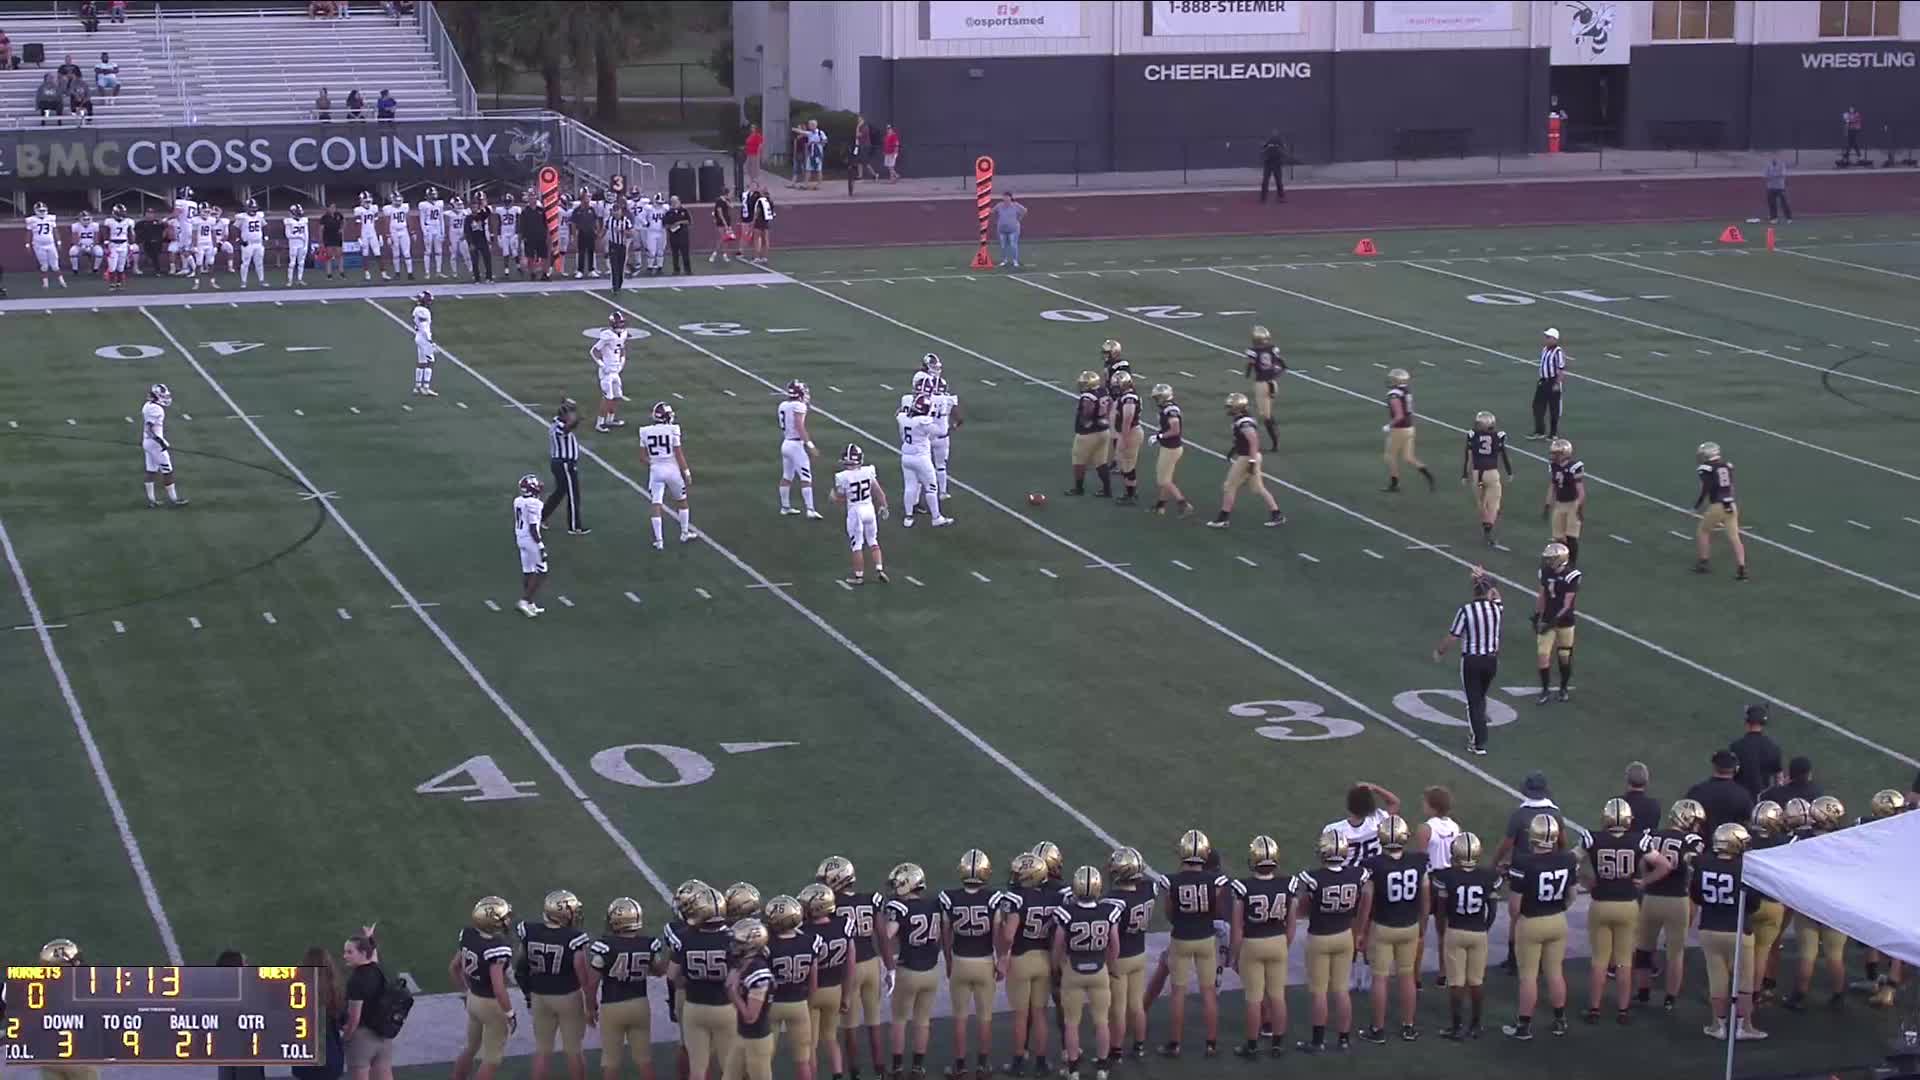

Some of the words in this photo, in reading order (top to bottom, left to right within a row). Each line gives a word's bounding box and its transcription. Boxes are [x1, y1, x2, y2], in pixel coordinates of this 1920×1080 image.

[1169, 1, 1286, 14] 1-888-STEEMER
[1144, 62, 1312, 81] CHEERLEADING
[1801, 51, 1916, 69] WRESTLING
[16, 142, 121, 178] BMC
[126, 138, 273, 175] CROSS
[288, 133, 497, 174] COUNTRY
[613, 175, 624, 191] 3
[648, 435, 671, 455] 24
[1478, 434, 1493, 455] 3
[849, 479, 872, 503] 32
[1597, 849, 1636, 880] 60
[1178, 884, 1210, 913] 91
[1320, 883, 1358, 912] 59
[1387, 868, 1418, 902] 68
[1456, 885, 1484, 915] 16
[1538, 869, 1569, 901] 67
[1702, 871, 1735, 905] 52
[953, 906, 991, 936] 25
[1248, 893, 1287, 922] 34
[908, 913, 942, 946] 24
[1070, 920, 1110, 951] 28
[527, 941, 564, 975] 57
[608, 952, 650, 981] 45
[686, 950, 728, 980] 55
[772, 953, 813, 985] 36
